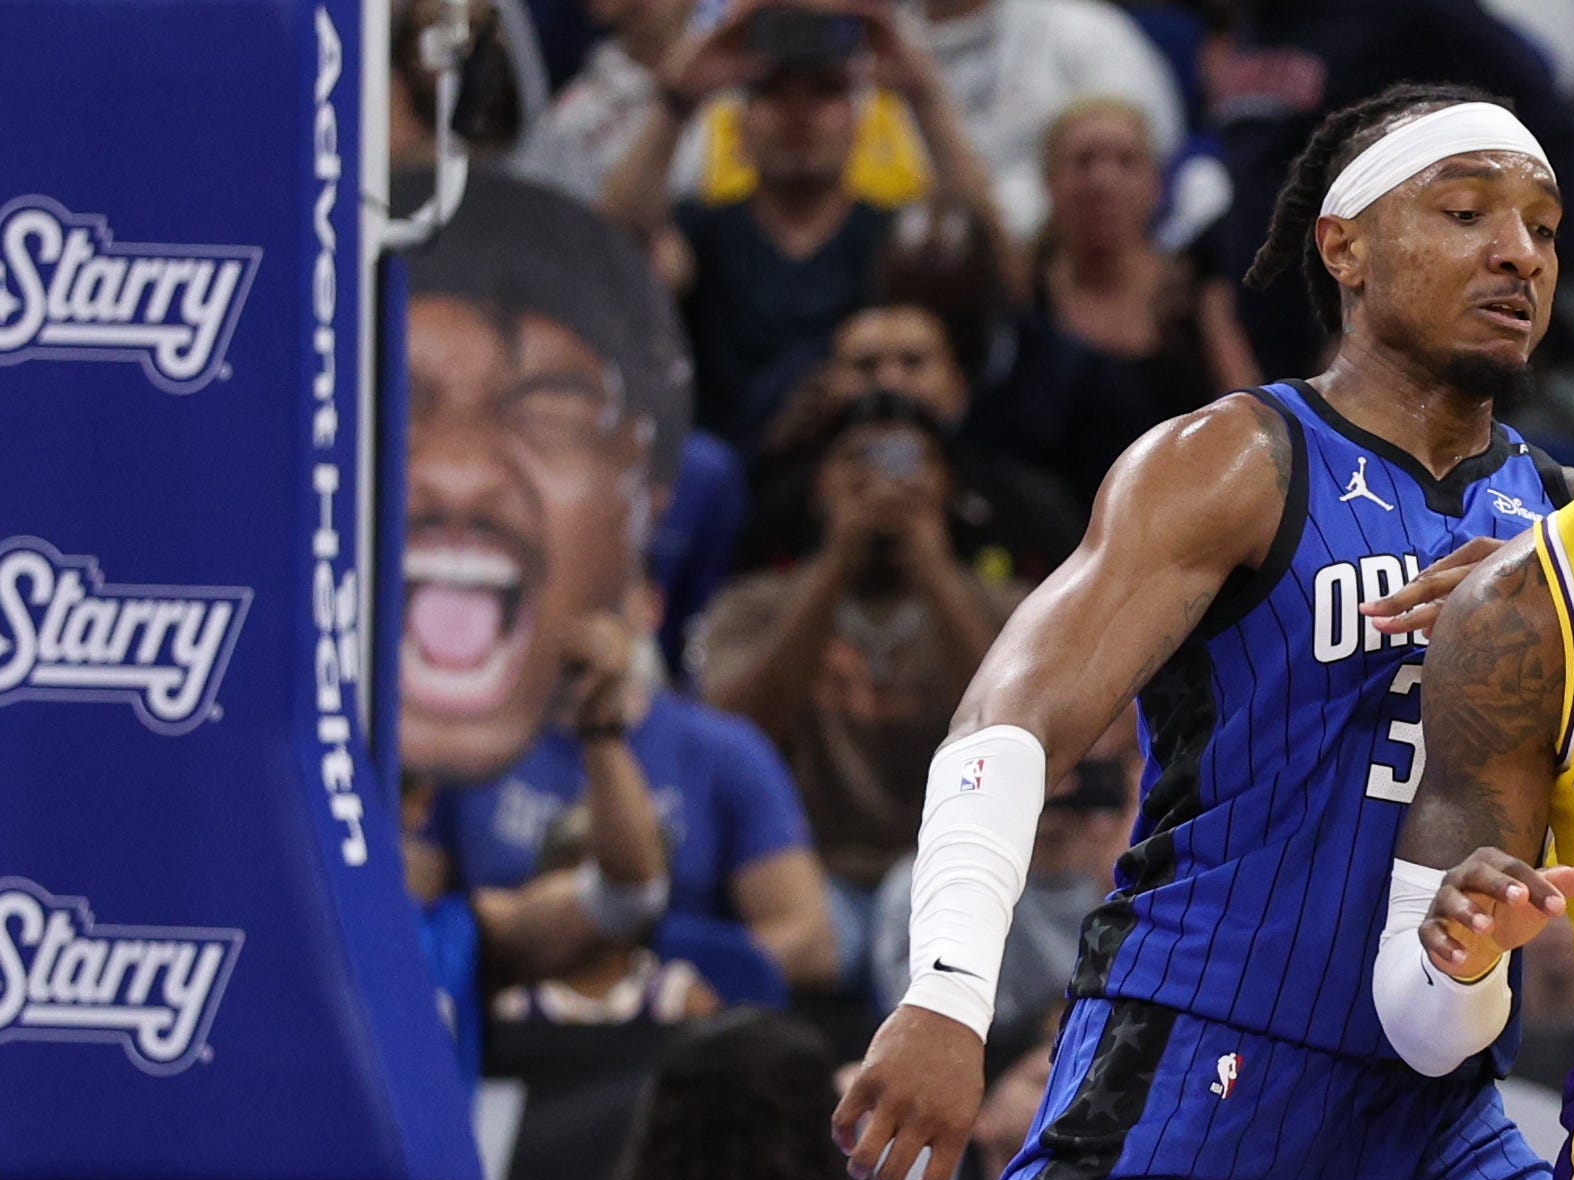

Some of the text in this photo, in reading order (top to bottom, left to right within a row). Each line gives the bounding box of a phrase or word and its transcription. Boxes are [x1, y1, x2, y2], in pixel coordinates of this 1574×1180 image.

[0, 208, 243, 378] Starry
[1486, 487, 1544, 521] Disne
[0, 549, 234, 720] Starry
[0, 889, 224, 1058] Starry
